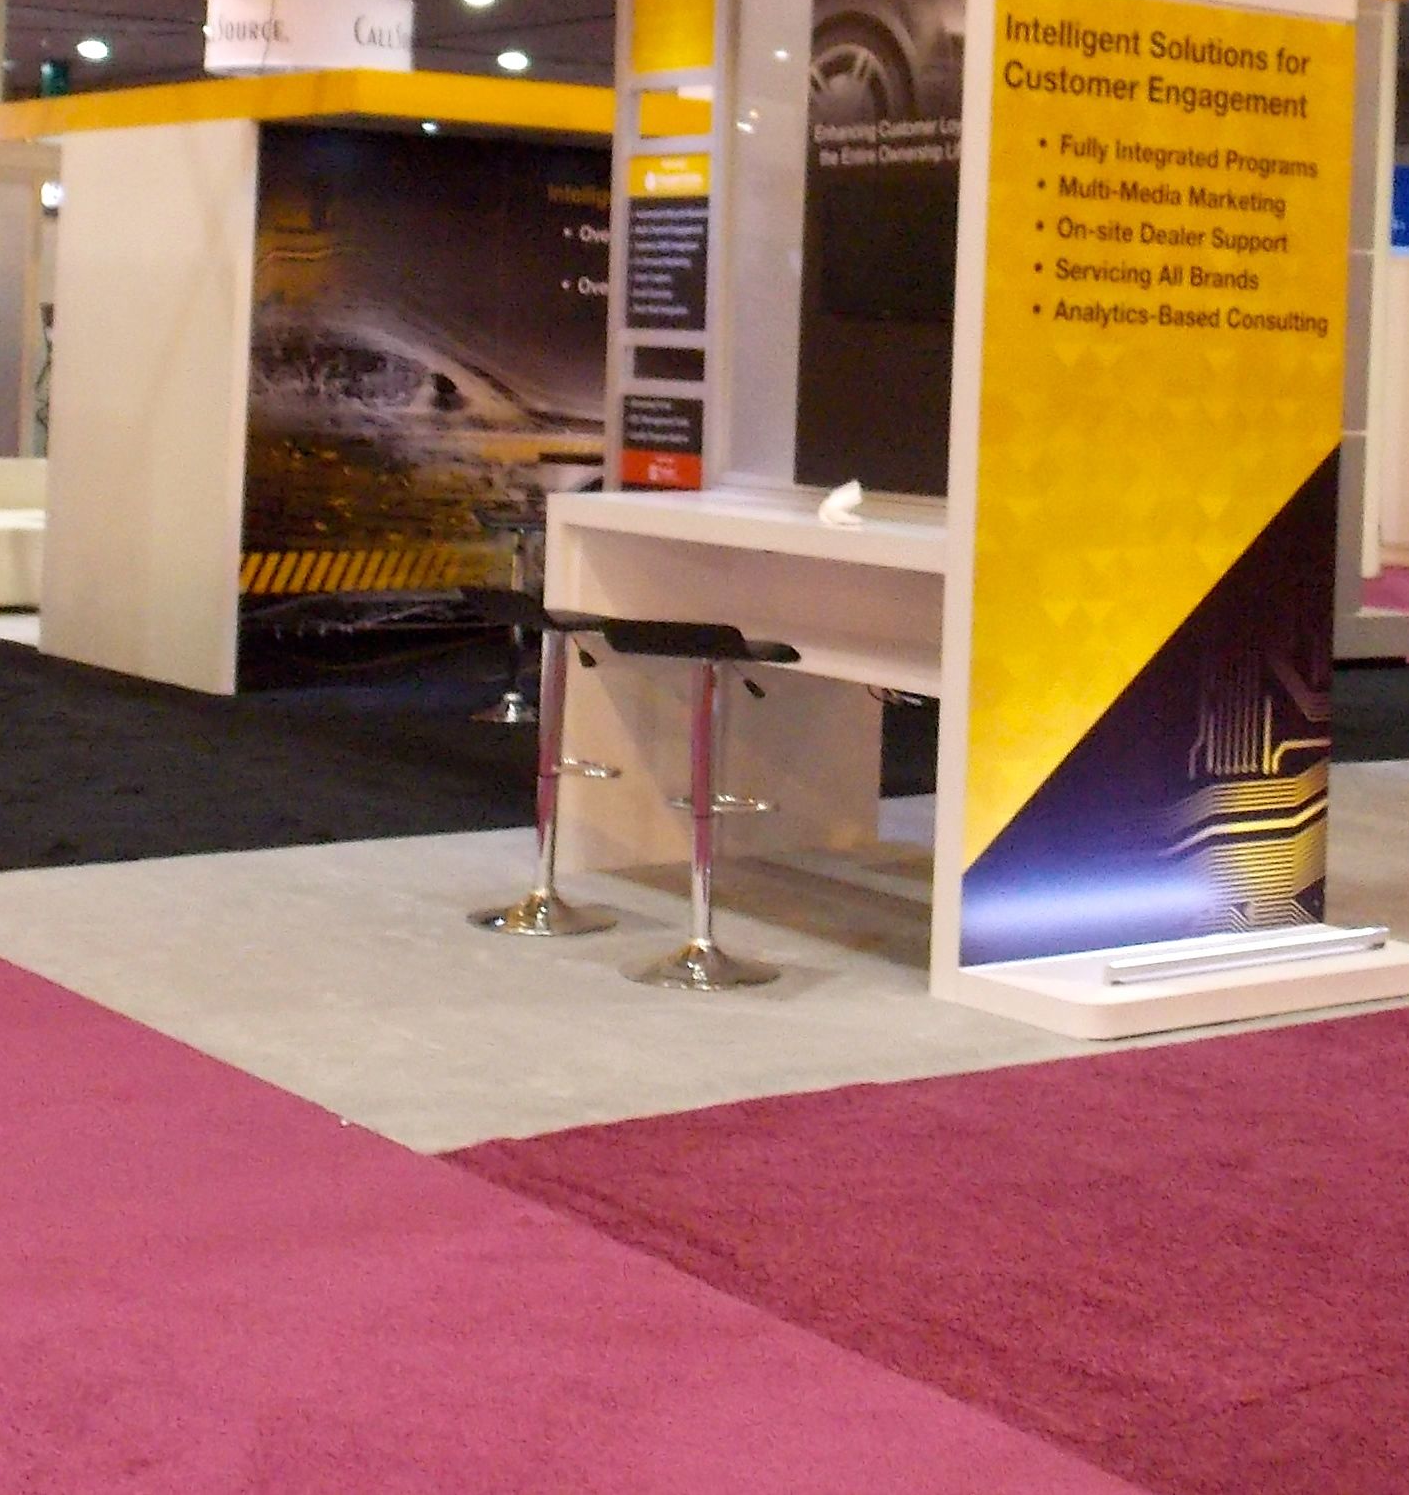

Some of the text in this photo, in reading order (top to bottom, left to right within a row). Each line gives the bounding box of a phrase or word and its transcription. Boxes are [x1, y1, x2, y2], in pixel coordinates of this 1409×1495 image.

[1005, 13, 1311, 76] Intelligent Solutions for
[1004, 59, 1309, 119] Customer Engagement
[1059, 133, 1319, 179] Fully Integrated Programs
[1059, 174, 1287, 219] Multi-Media Marketing
[1056, 216, 1289, 254] On-site Dealer Support
[1055, 257, 1260, 290] Servicing All Brands
[1053, 301, 1329, 338] Analytics-Based Consulting
